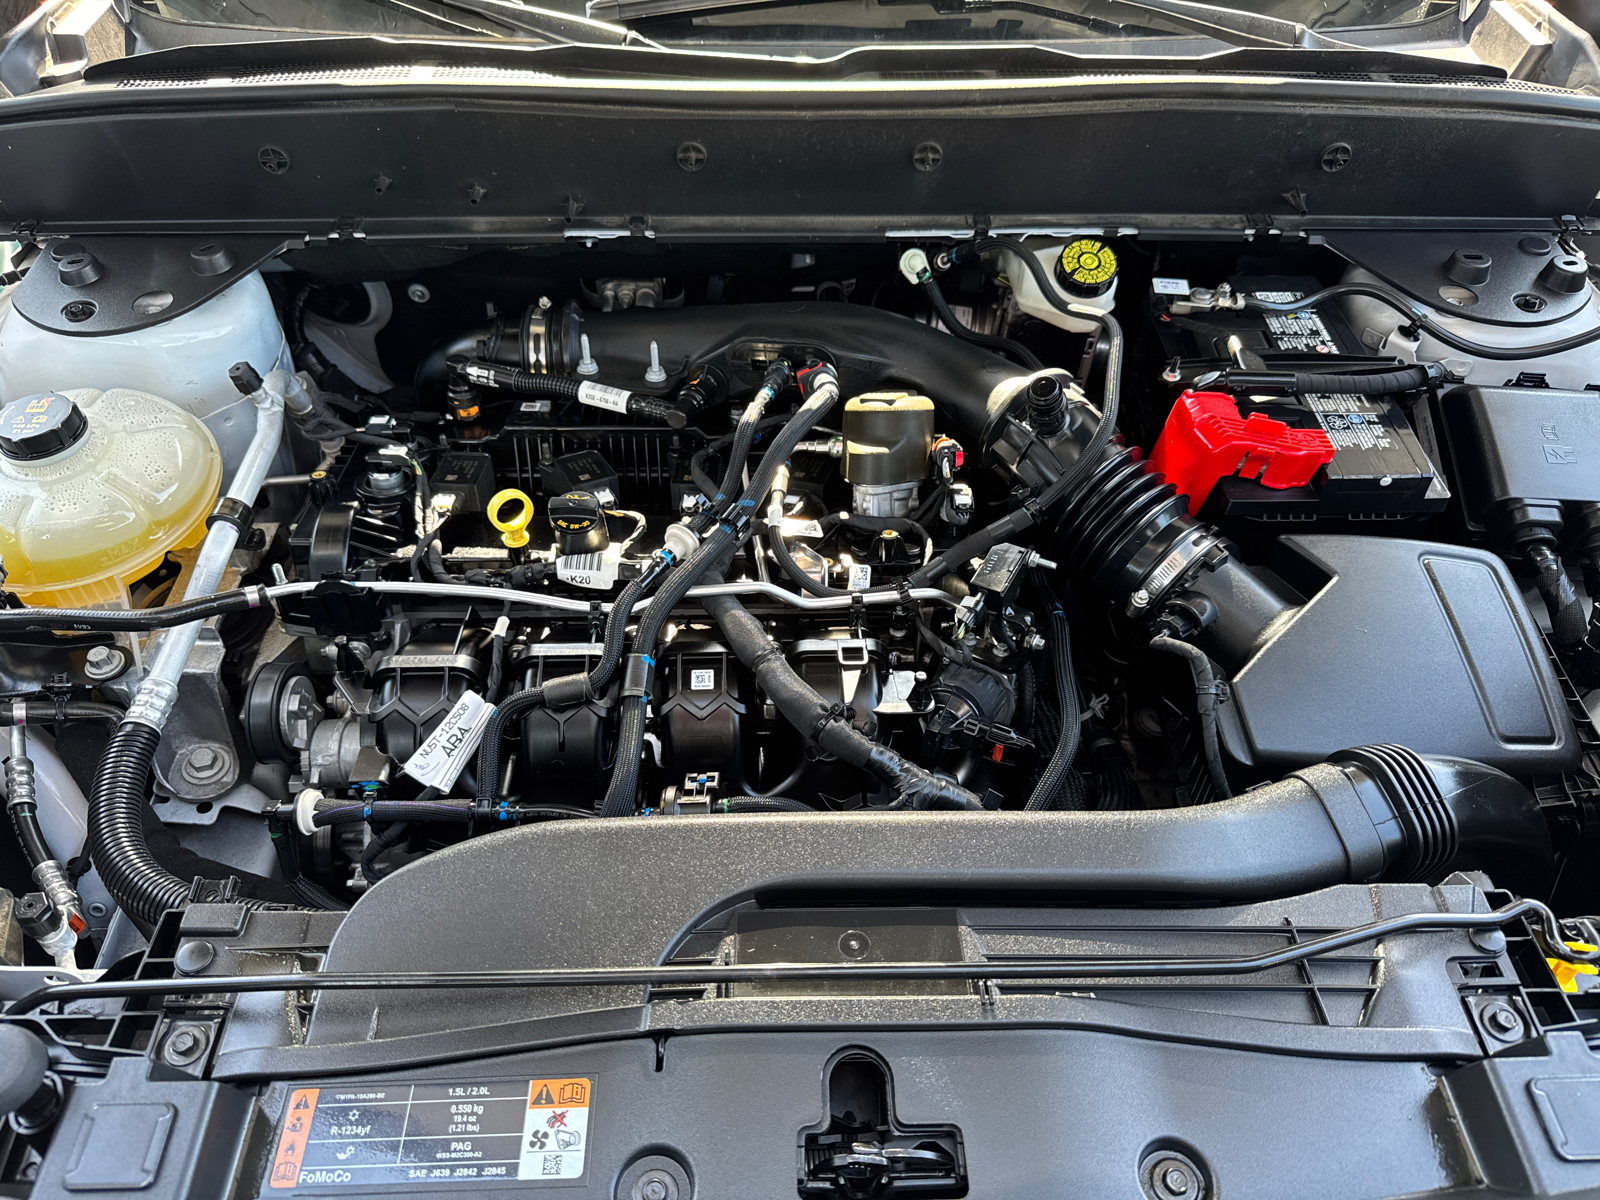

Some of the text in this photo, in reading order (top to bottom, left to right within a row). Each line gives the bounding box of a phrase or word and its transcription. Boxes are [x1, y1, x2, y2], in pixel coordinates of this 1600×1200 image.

[556, 519, 591, 530] SAE 5W-30
[419, 702, 470, 760] NU5T-12C508
[441, 726, 473, 759] ABA
[448, 1087, 466, 1096] 1.5L
[472, 1086, 490, 1095] 2.0L
[450, 1104, 484, 1114] 0.550 kg
[453, 1115, 467, 1123] 19.4
[330, 1125, 372, 1136] R-1234yf
[448, 1123, 480, 1133] (1.21 lbs)
[450, 1142, 472, 1151] PAG
[299, 1169, 352, 1184] FoMoCo
[409, 1167, 507, 1178] SAE J639 J2842 J2845
